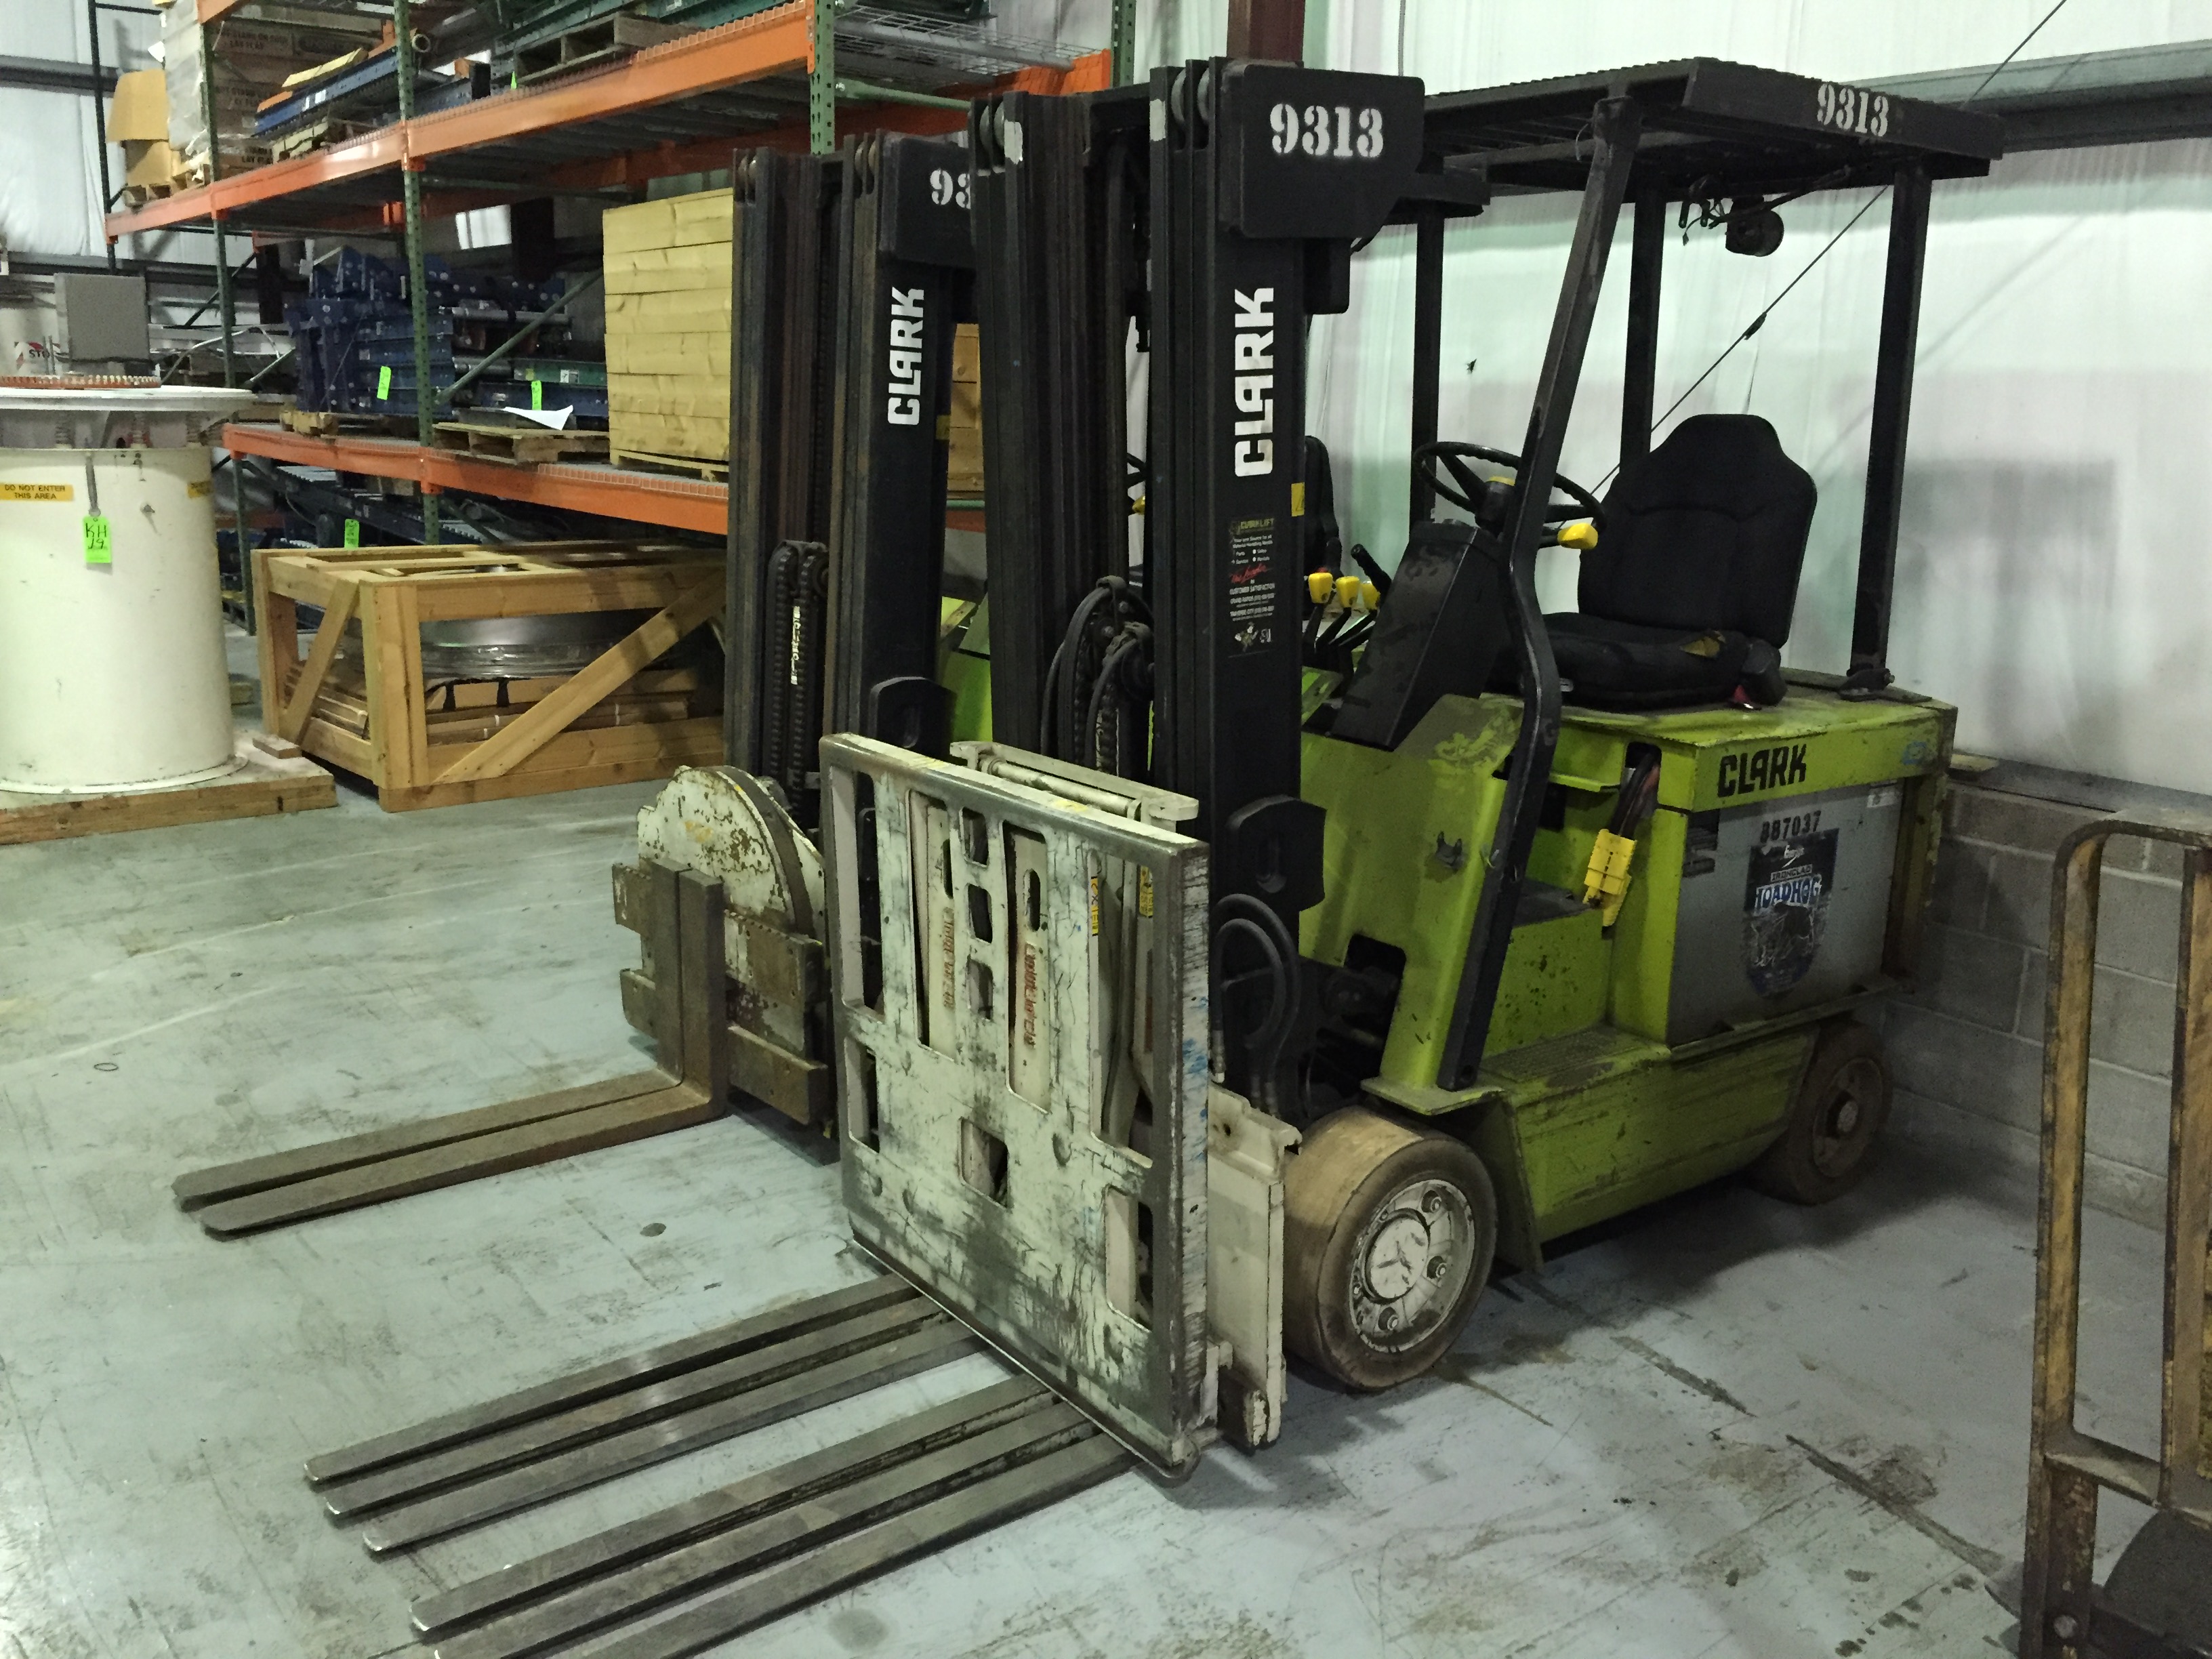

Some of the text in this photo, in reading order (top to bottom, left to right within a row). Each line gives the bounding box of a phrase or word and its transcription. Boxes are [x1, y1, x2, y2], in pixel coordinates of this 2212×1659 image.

[1269, 102, 1384, 158] 9313
[1817, 83, 1889, 137] 9313
[29, 349, 50, 359] STO
[887, 287, 924, 426] CLARK
[1234, 287, 1274, 477] CLARK
[1717, 743, 1807, 798] CLARK
[1760, 810, 1822, 843] 887037
